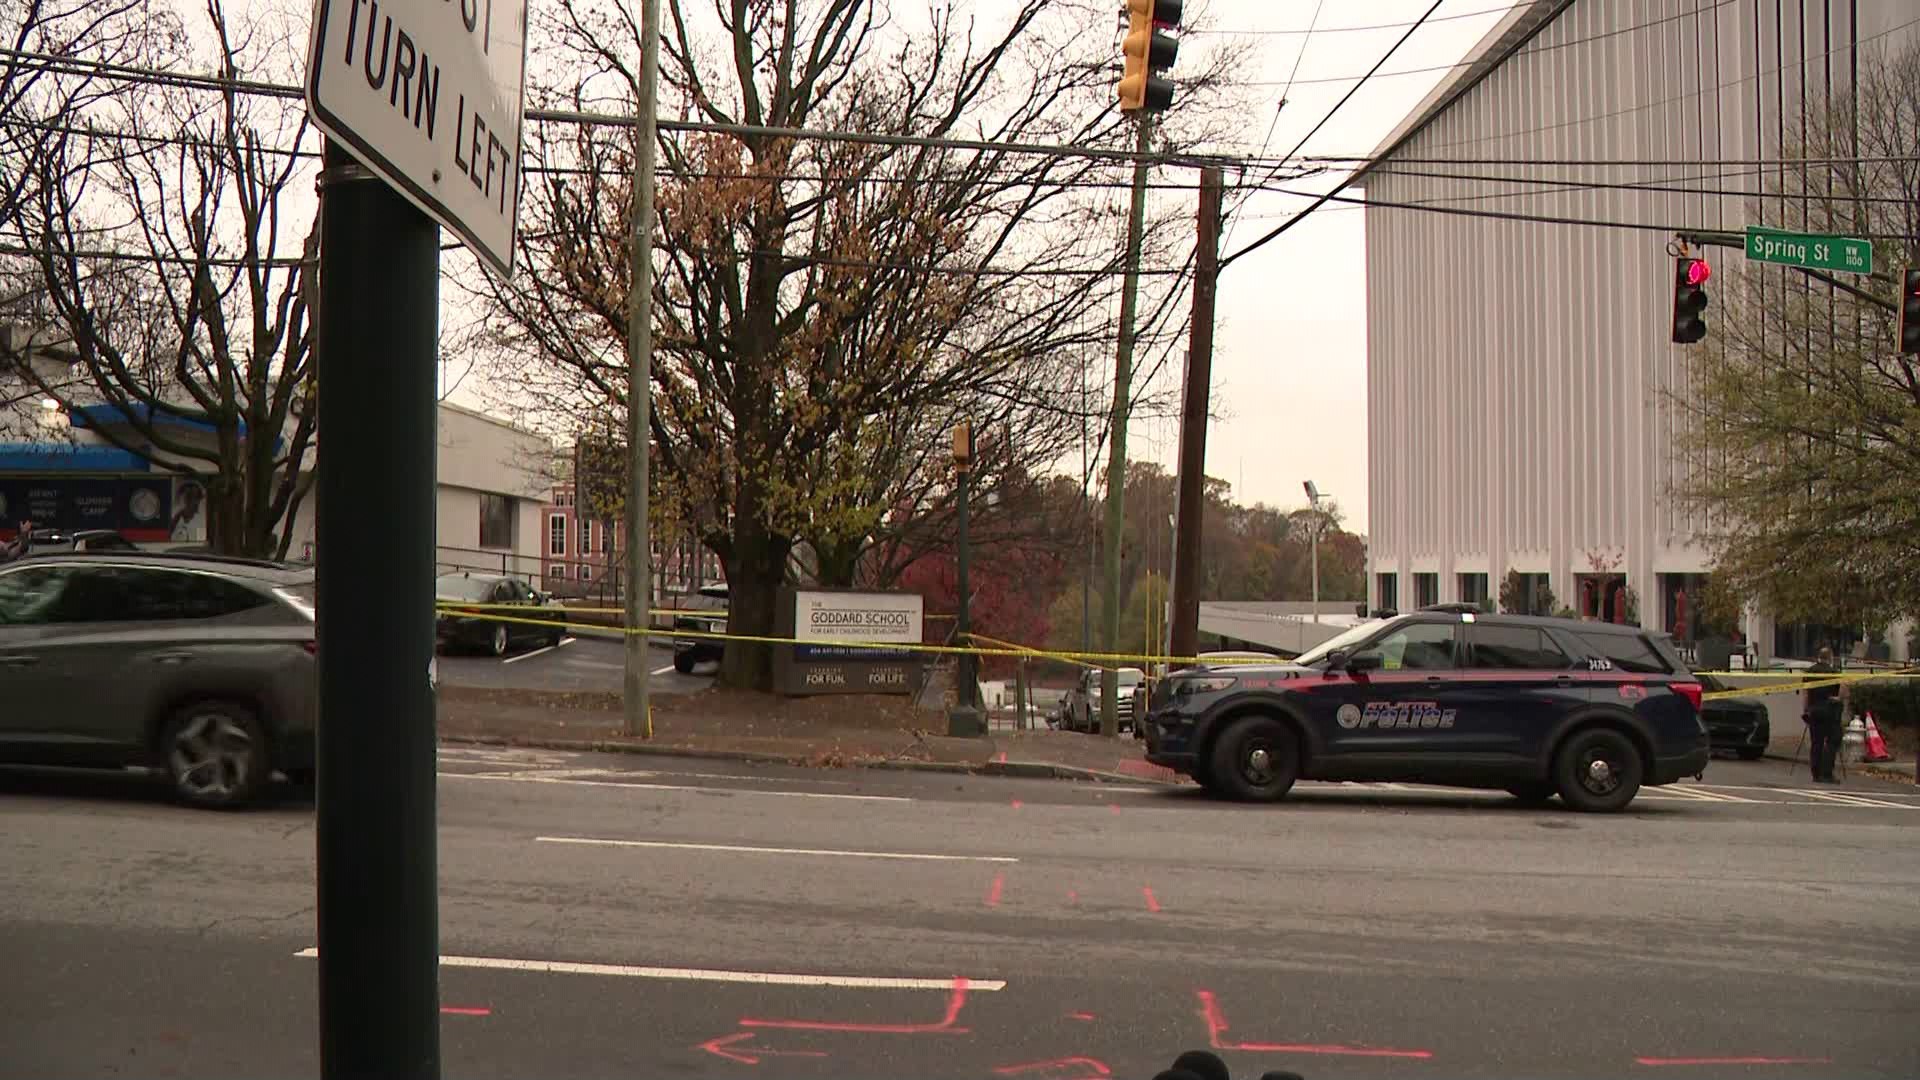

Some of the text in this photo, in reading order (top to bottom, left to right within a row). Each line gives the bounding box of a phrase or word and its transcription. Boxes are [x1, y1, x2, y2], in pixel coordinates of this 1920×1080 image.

[345, 0, 440, 141] TURN
[454, 94, 511, 214] LEFT
[1754, 235, 1830, 264] Spring St
[1845, 246, 1858, 255] NW
[1845, 255, 1863, 267] 1100
[811, 612, 910, 625] GODDARD SCHOOL
[806, 674, 825, 685] FOR
[868, 673, 886, 684] FOR
[1359, 709, 1457, 729] POLICE
